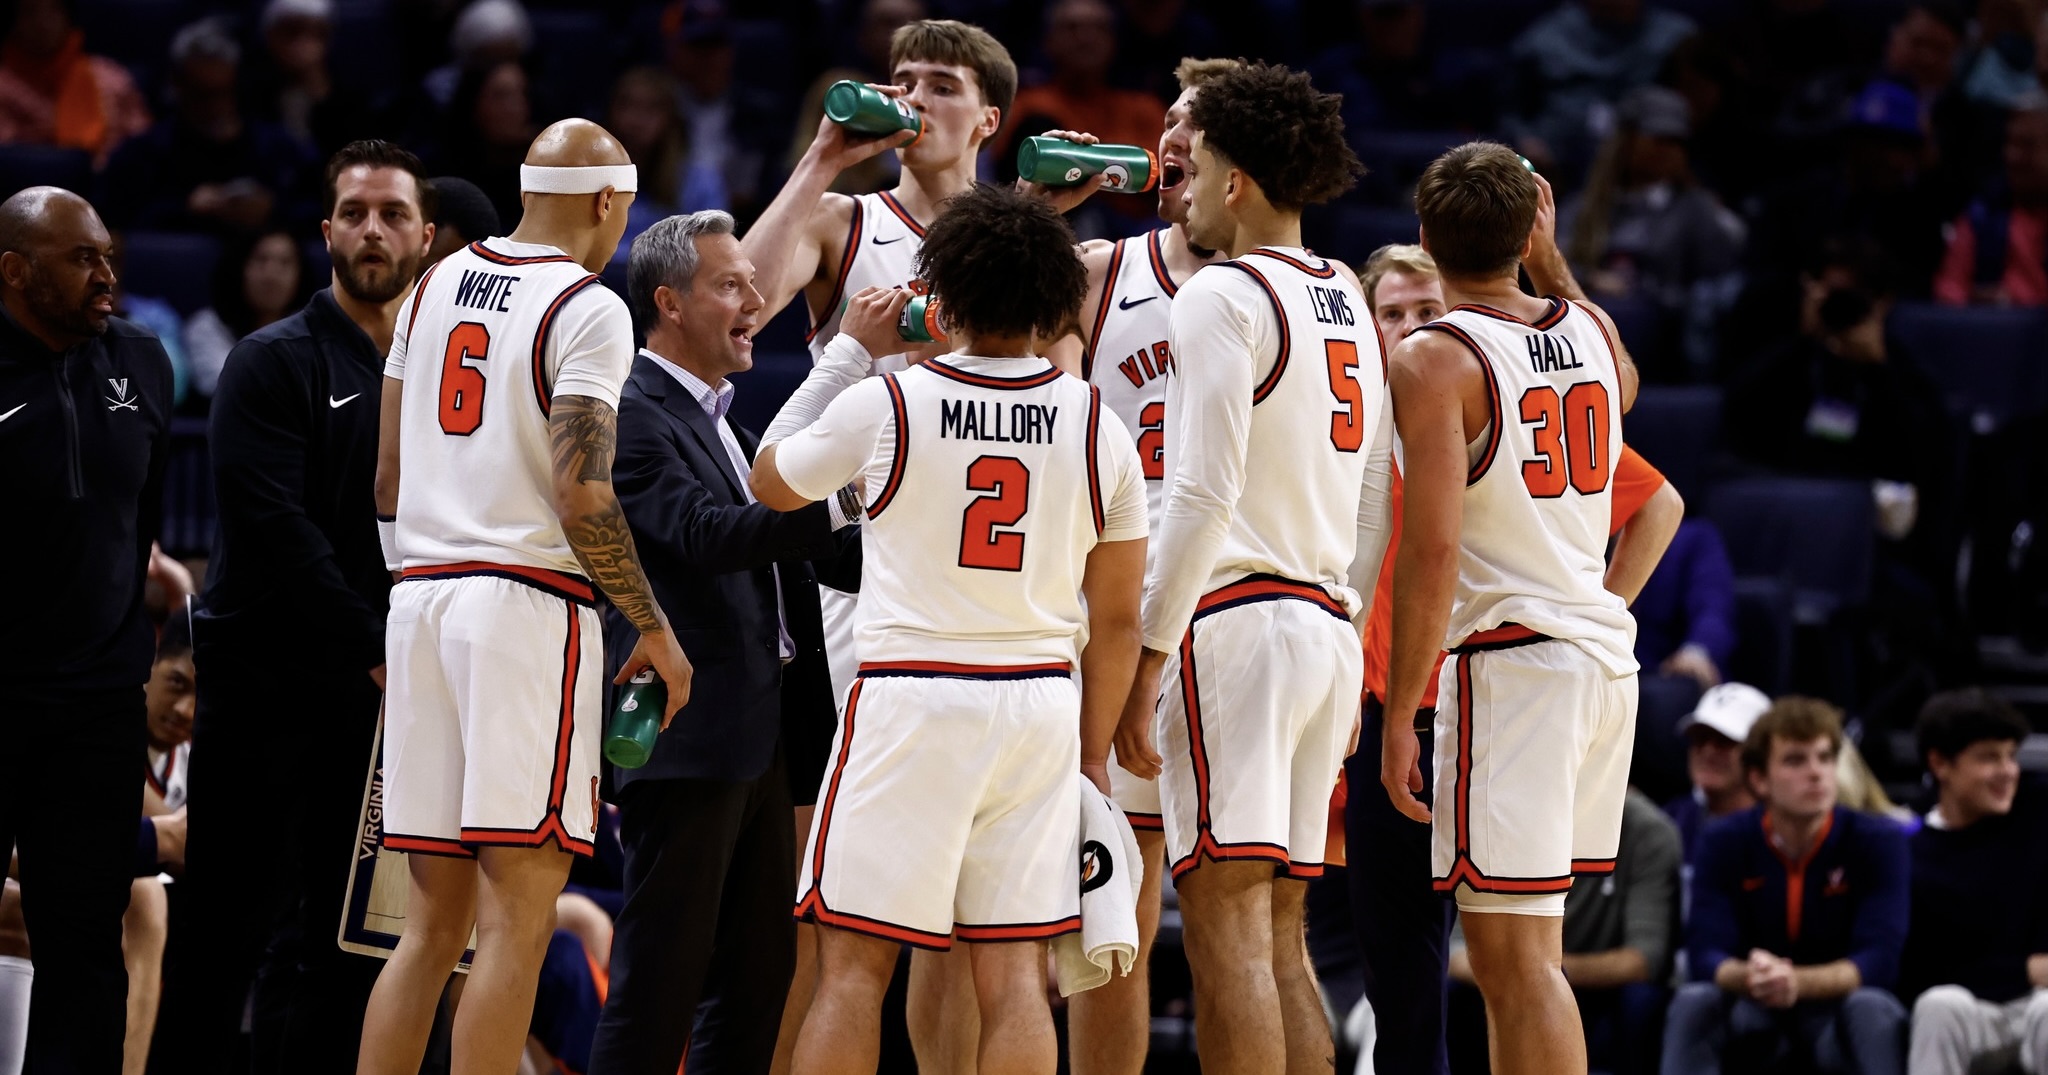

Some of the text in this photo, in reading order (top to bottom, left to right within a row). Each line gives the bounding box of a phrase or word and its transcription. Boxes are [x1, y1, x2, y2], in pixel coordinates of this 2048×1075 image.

[455, 269, 521, 313] WHITE
[1306, 285, 1355, 327] LEWIS
[438, 321, 491, 437] 6
[1526, 333, 1584, 373] HALL
[940, 398, 1058, 445] MALLORY
[1324, 338, 1364, 453] 5
[1518, 380, 1611, 499] 30
[958, 454, 1030, 572] 2
